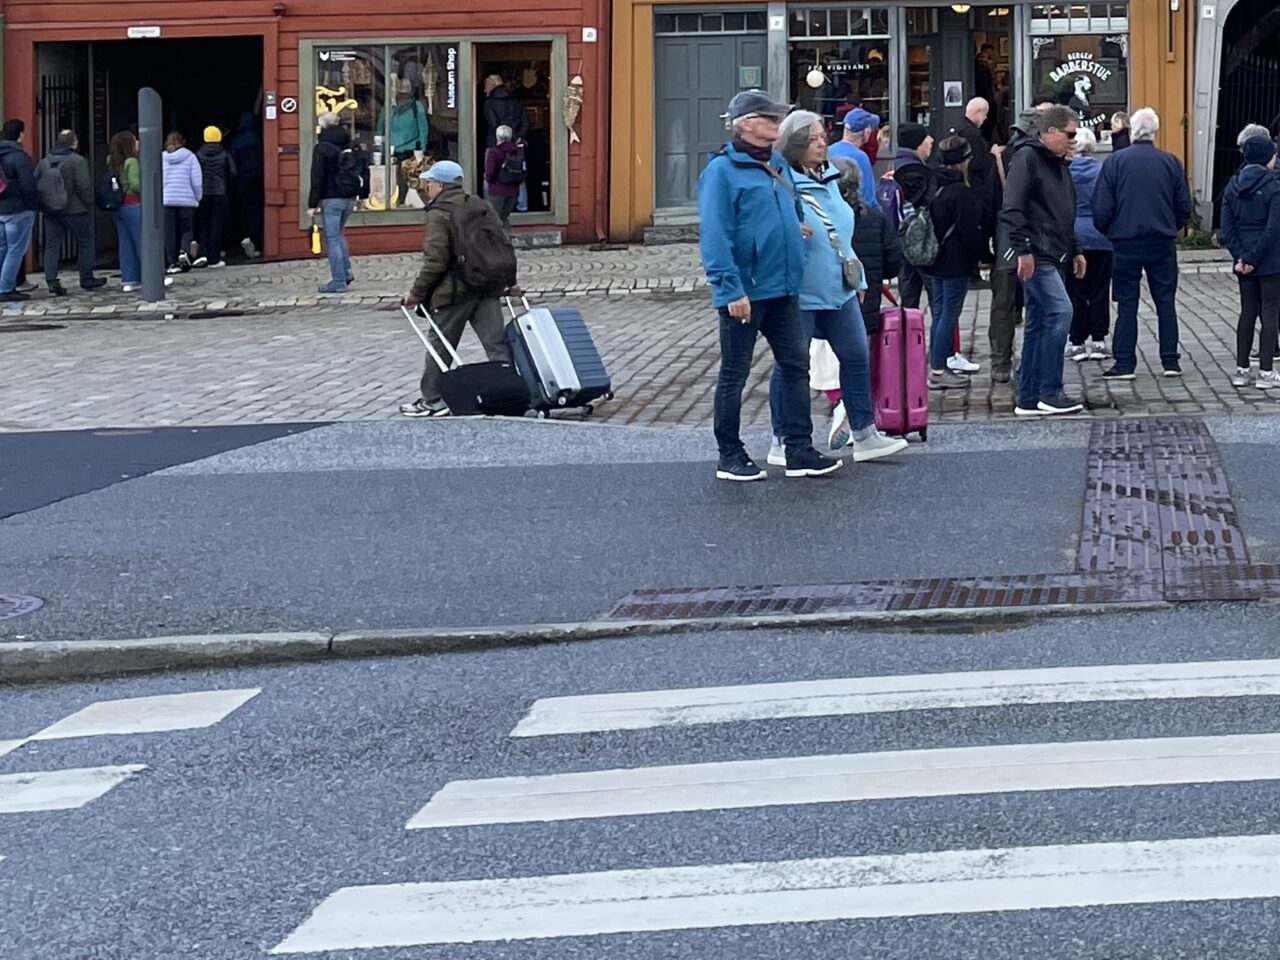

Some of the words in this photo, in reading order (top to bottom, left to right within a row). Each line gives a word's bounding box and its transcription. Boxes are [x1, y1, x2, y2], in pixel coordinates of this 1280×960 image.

[446, 48, 457, 70] Shop
[1049, 60, 1112, 82] BARBERSTUE
[447, 71, 455, 108] Museum
